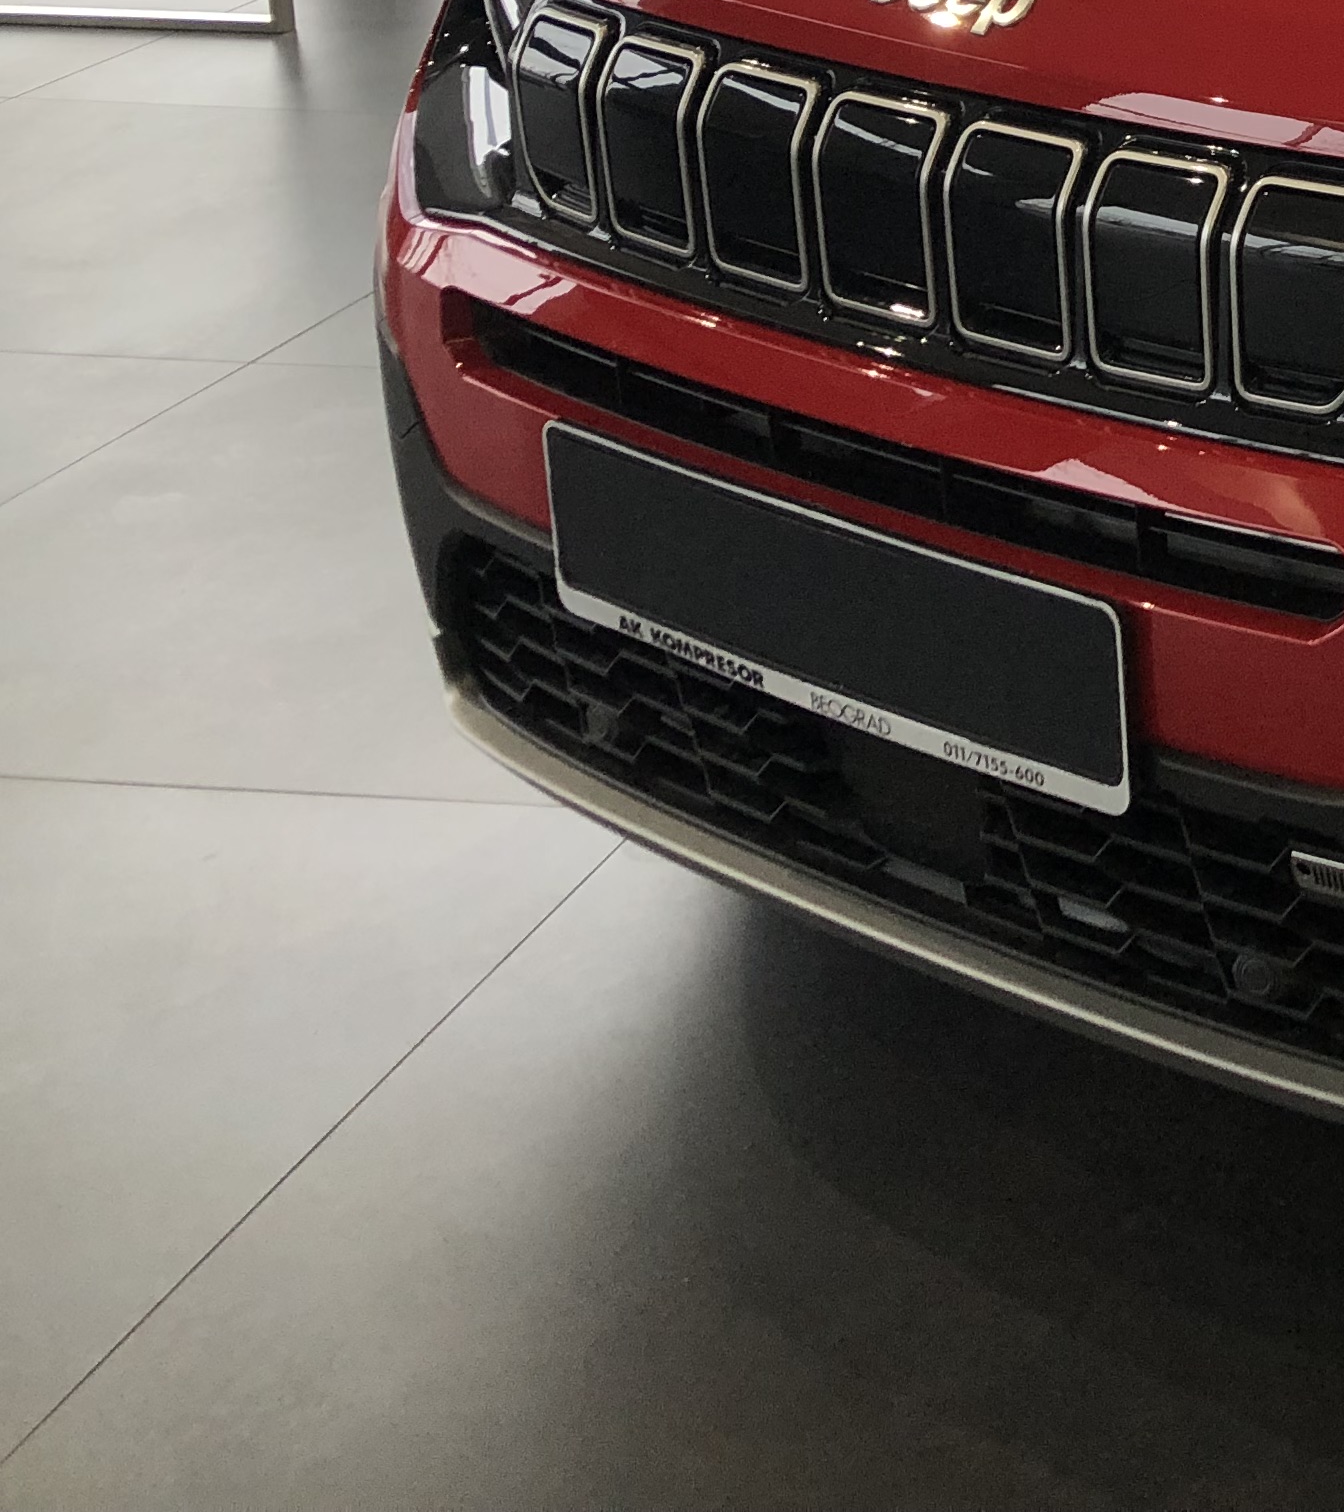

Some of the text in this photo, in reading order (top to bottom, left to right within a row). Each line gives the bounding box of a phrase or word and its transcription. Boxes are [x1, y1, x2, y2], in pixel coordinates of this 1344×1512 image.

[619, 615, 1046, 788] AK KOMPRESOR BEOGRAD 011/7155-600
